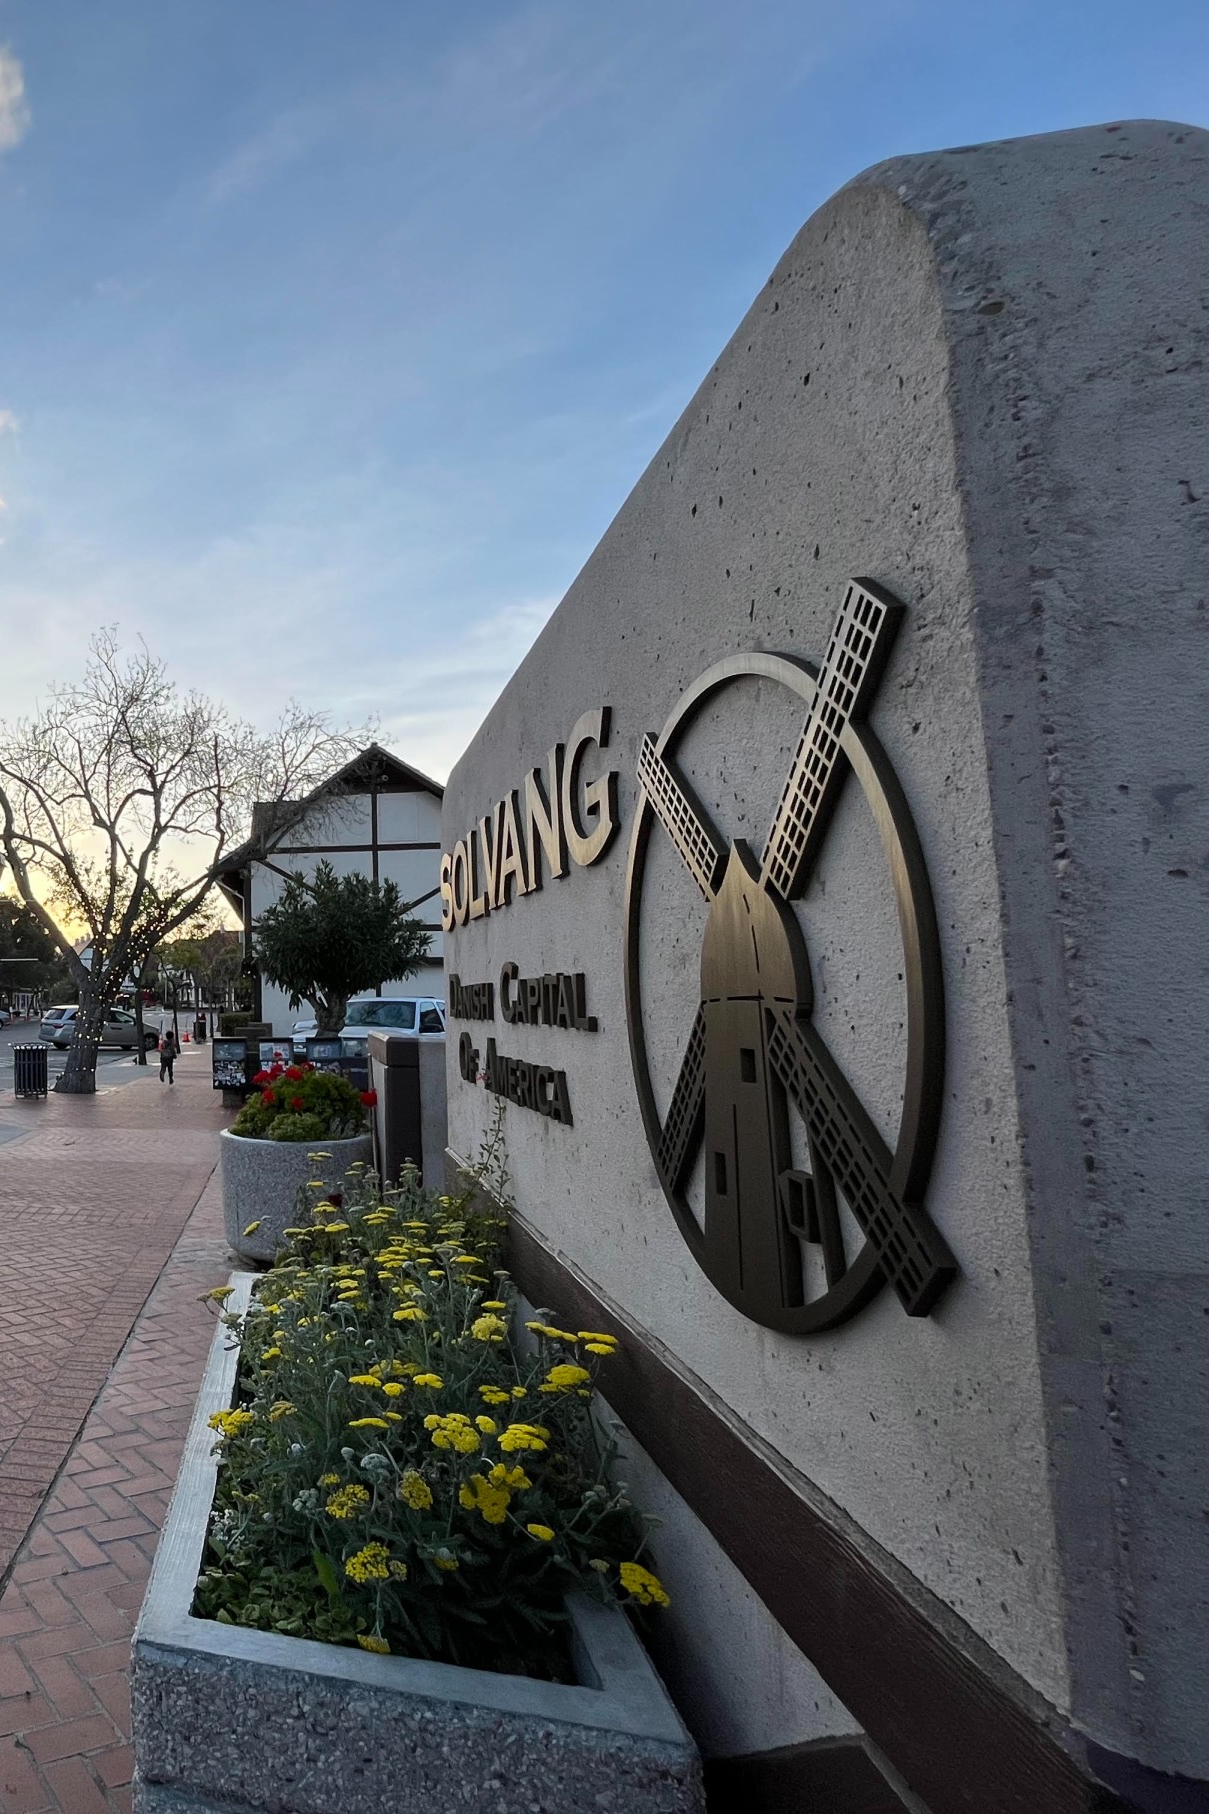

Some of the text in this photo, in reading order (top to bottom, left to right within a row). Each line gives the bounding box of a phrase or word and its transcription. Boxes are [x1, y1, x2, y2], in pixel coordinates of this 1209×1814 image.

[440, 706, 621, 932] SOLVANG
[500, 961, 599, 1032] CAPITAL
[484, 1037, 574, 1127] AMERICA
